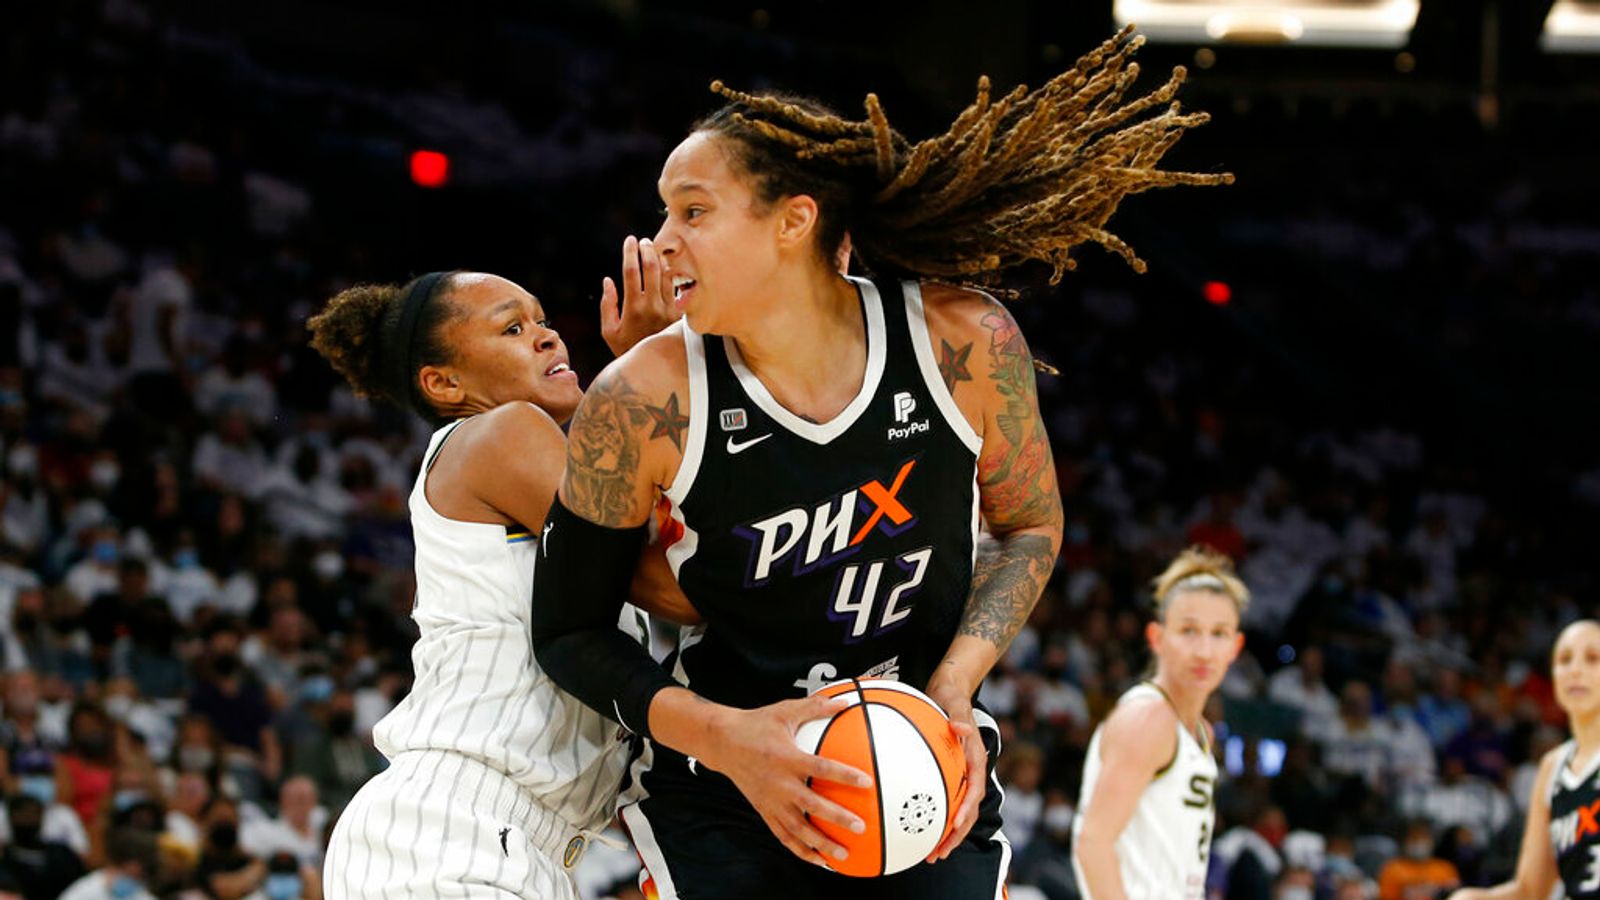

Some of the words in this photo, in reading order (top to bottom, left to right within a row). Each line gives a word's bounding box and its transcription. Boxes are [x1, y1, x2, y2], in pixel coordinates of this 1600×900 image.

[888, 419, 930, 441] PayPal
[749, 458, 917, 581] PHX
[833, 548, 933, 638] 42
